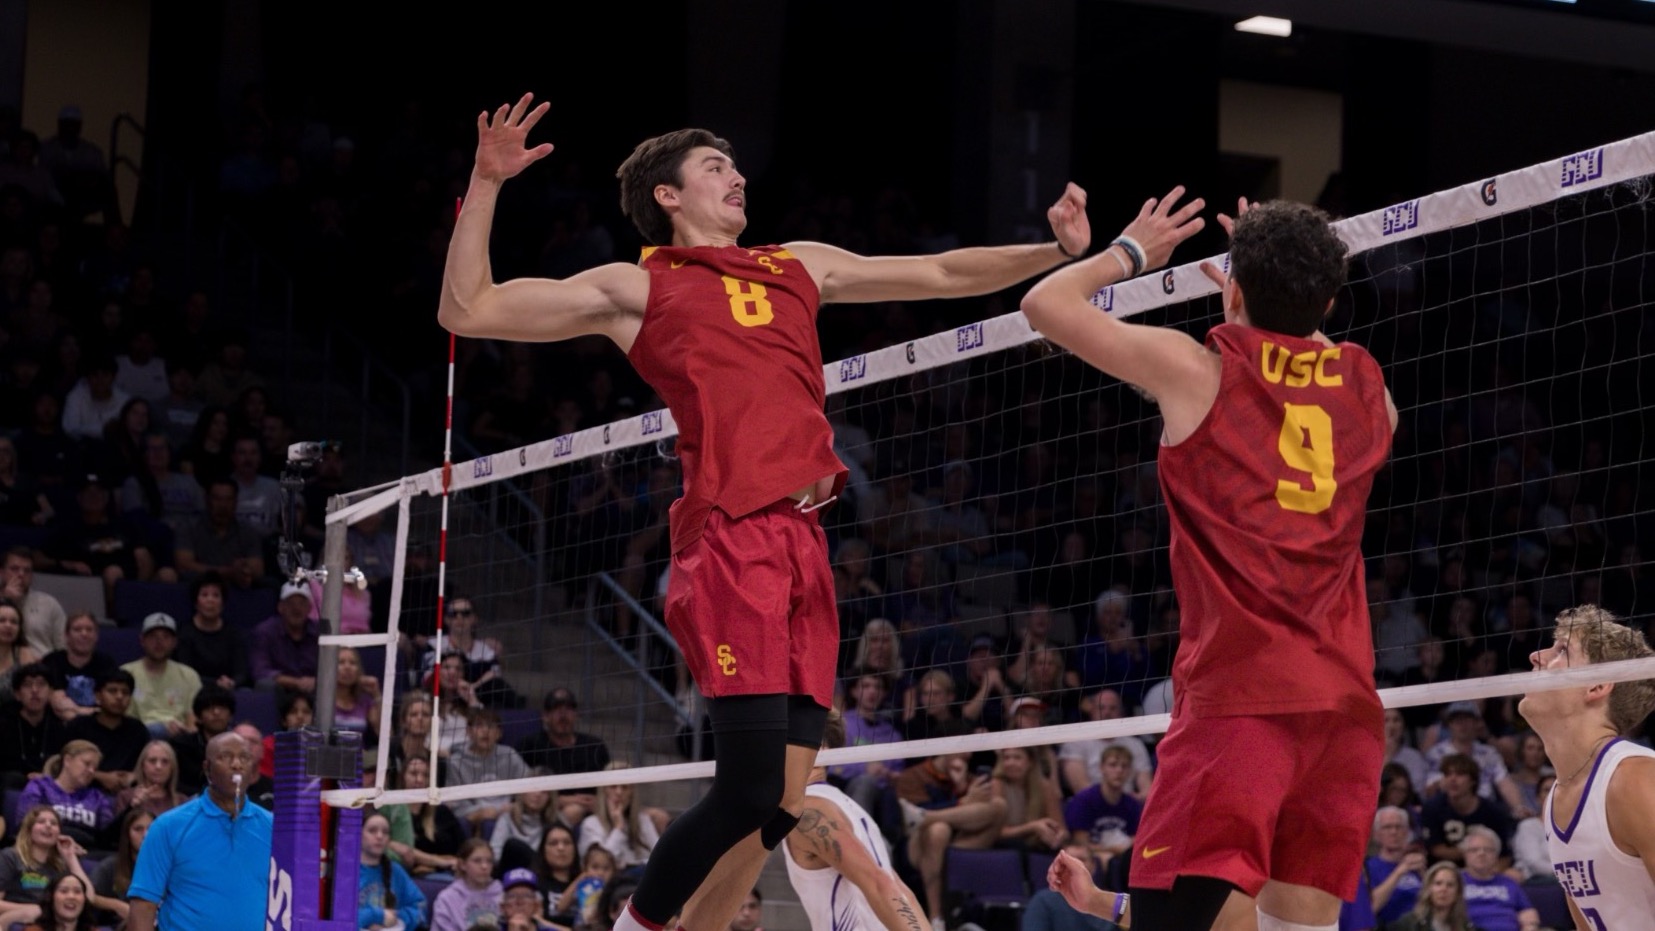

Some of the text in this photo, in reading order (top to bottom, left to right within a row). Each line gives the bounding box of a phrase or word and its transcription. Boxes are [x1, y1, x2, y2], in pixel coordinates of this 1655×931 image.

[1561, 148, 1604, 188] GCU
[1481, 178, 1496, 206] G
[1383, 199, 1420, 236] GCU
[721, 275, 774, 327] 8
[957, 322, 984, 352] GCU
[840, 354, 867, 383] GCU
[1262, 341, 1343, 388] USC
[641, 410, 663, 435] GCU
[553, 433, 574, 457] GCU
[1275, 401, 1337, 515] 9
[717, 644, 737, 676] SC
